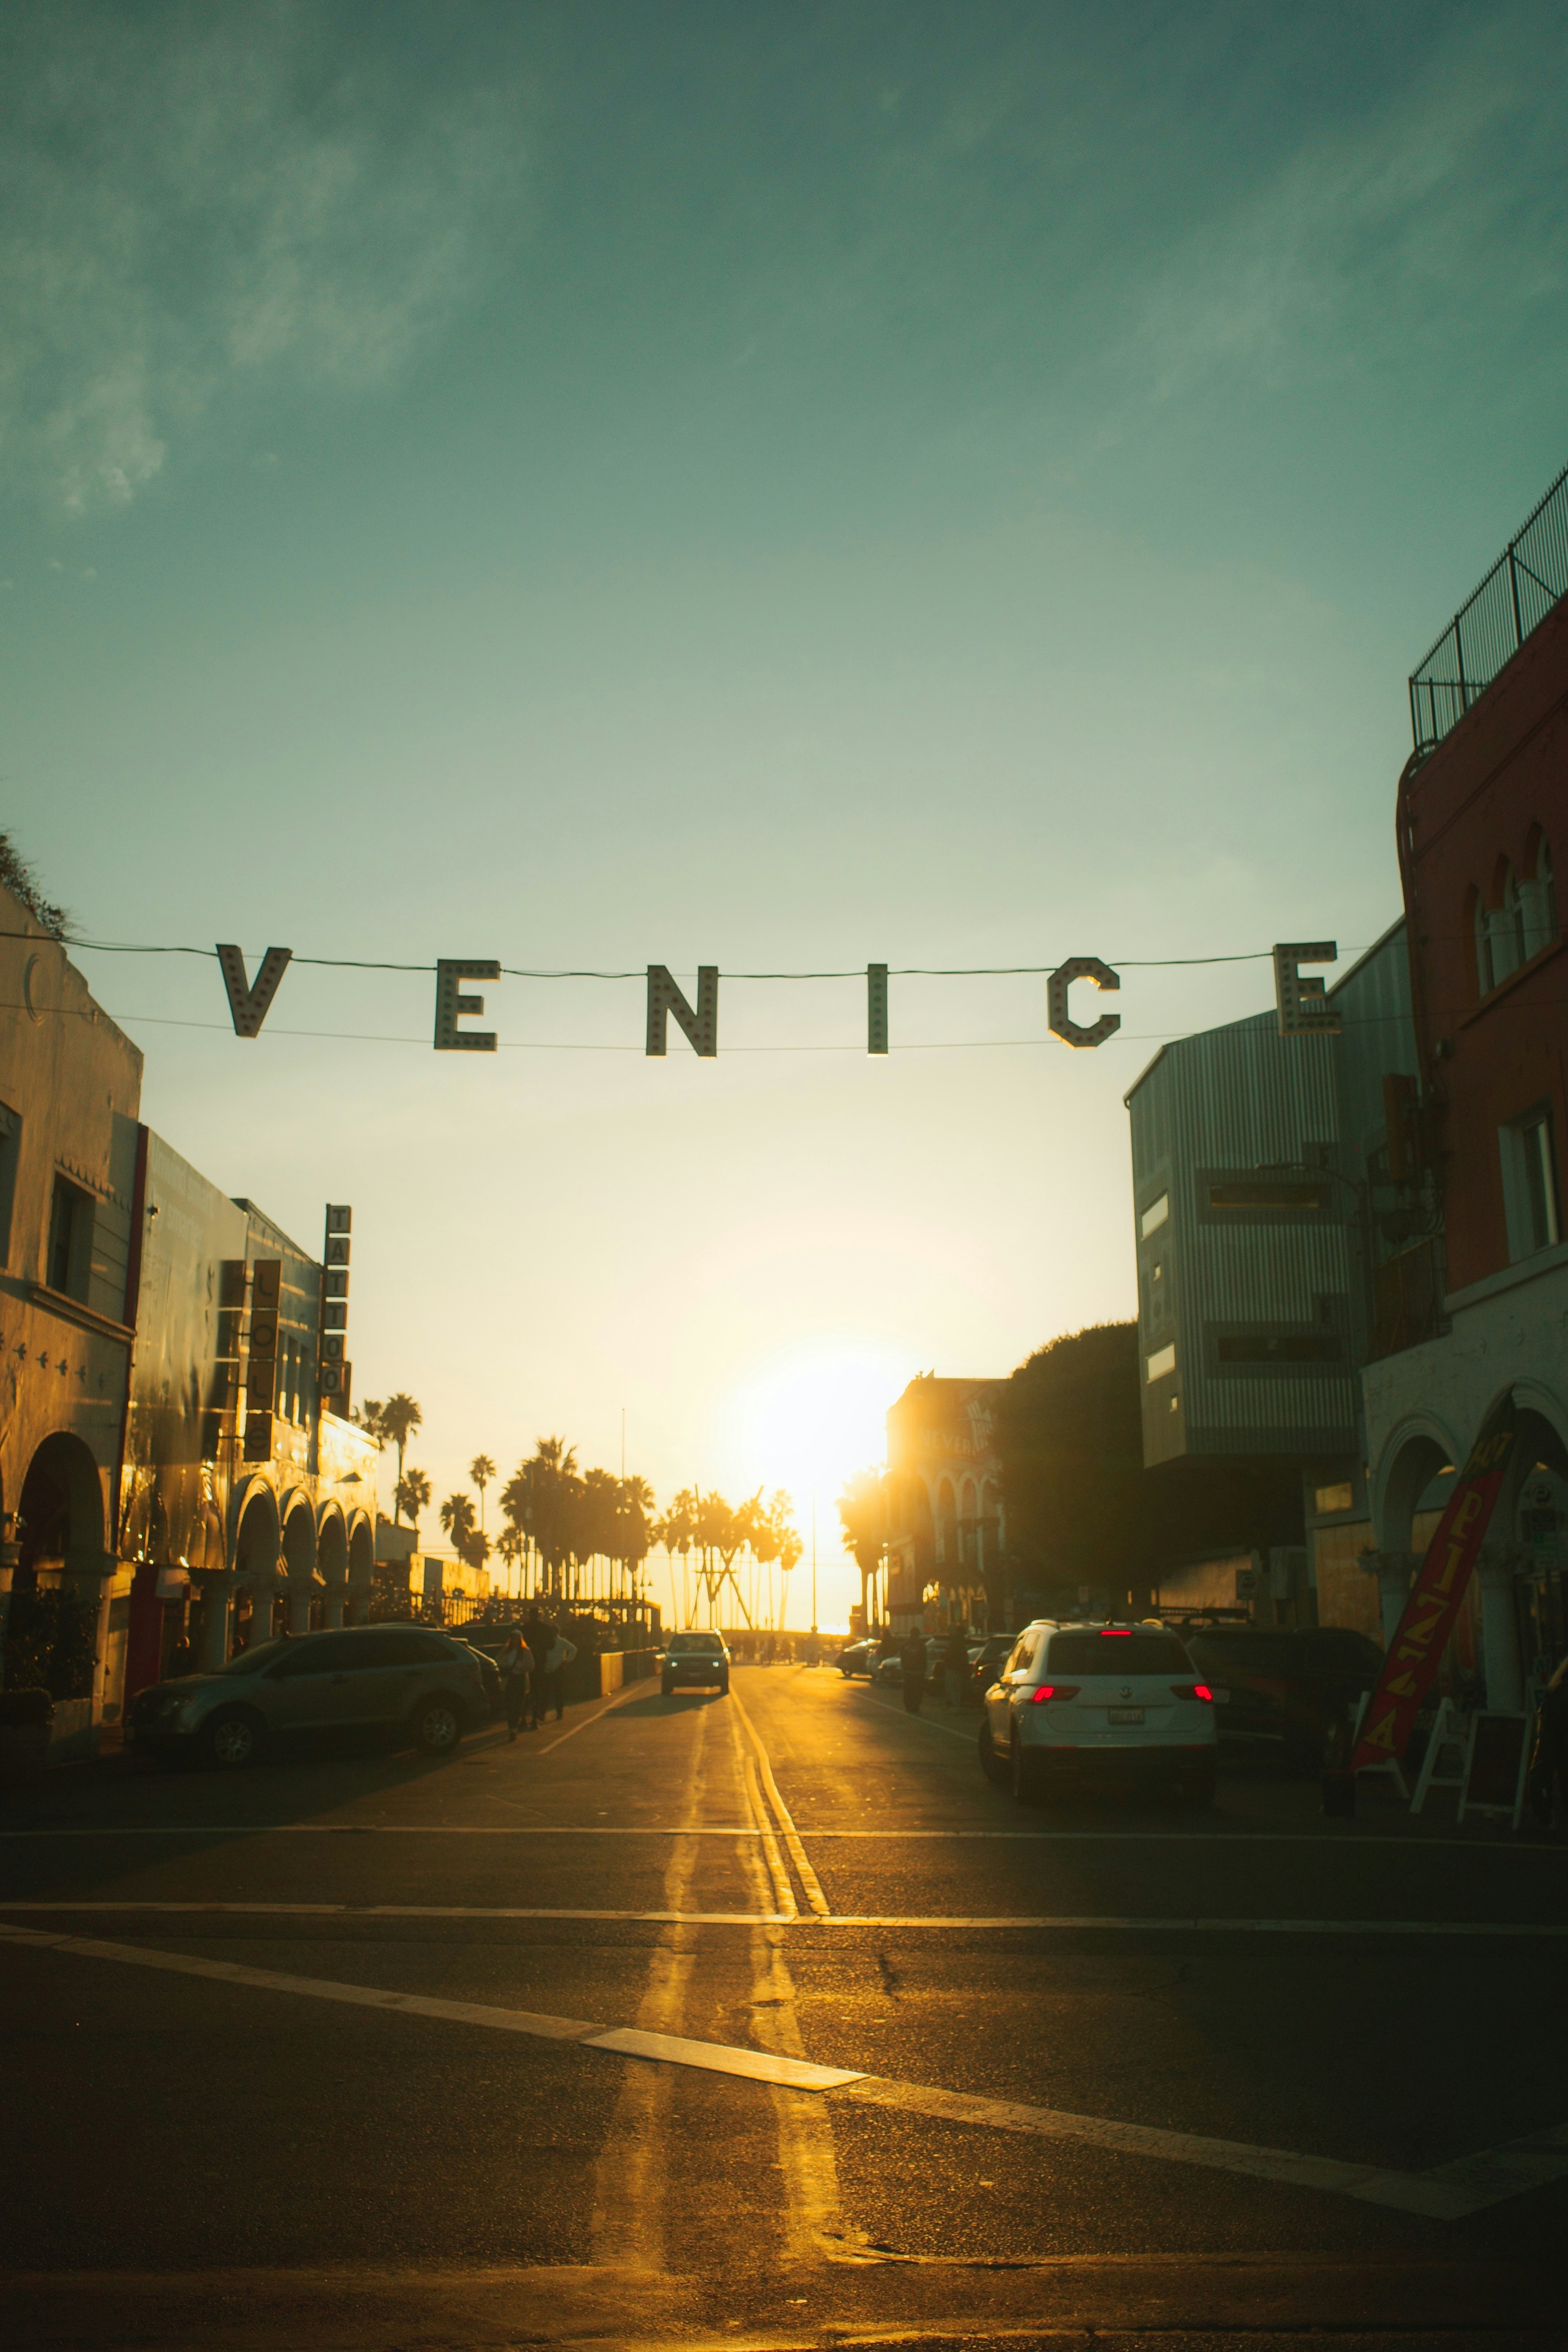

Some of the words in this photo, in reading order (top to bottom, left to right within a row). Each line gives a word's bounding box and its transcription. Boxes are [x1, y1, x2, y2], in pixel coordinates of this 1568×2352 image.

[215, 941, 1342, 1058] VENICE
[325, 1209, 347, 1385] TATTOO
[1365, 1490, 1483, 1753] PIZZA
